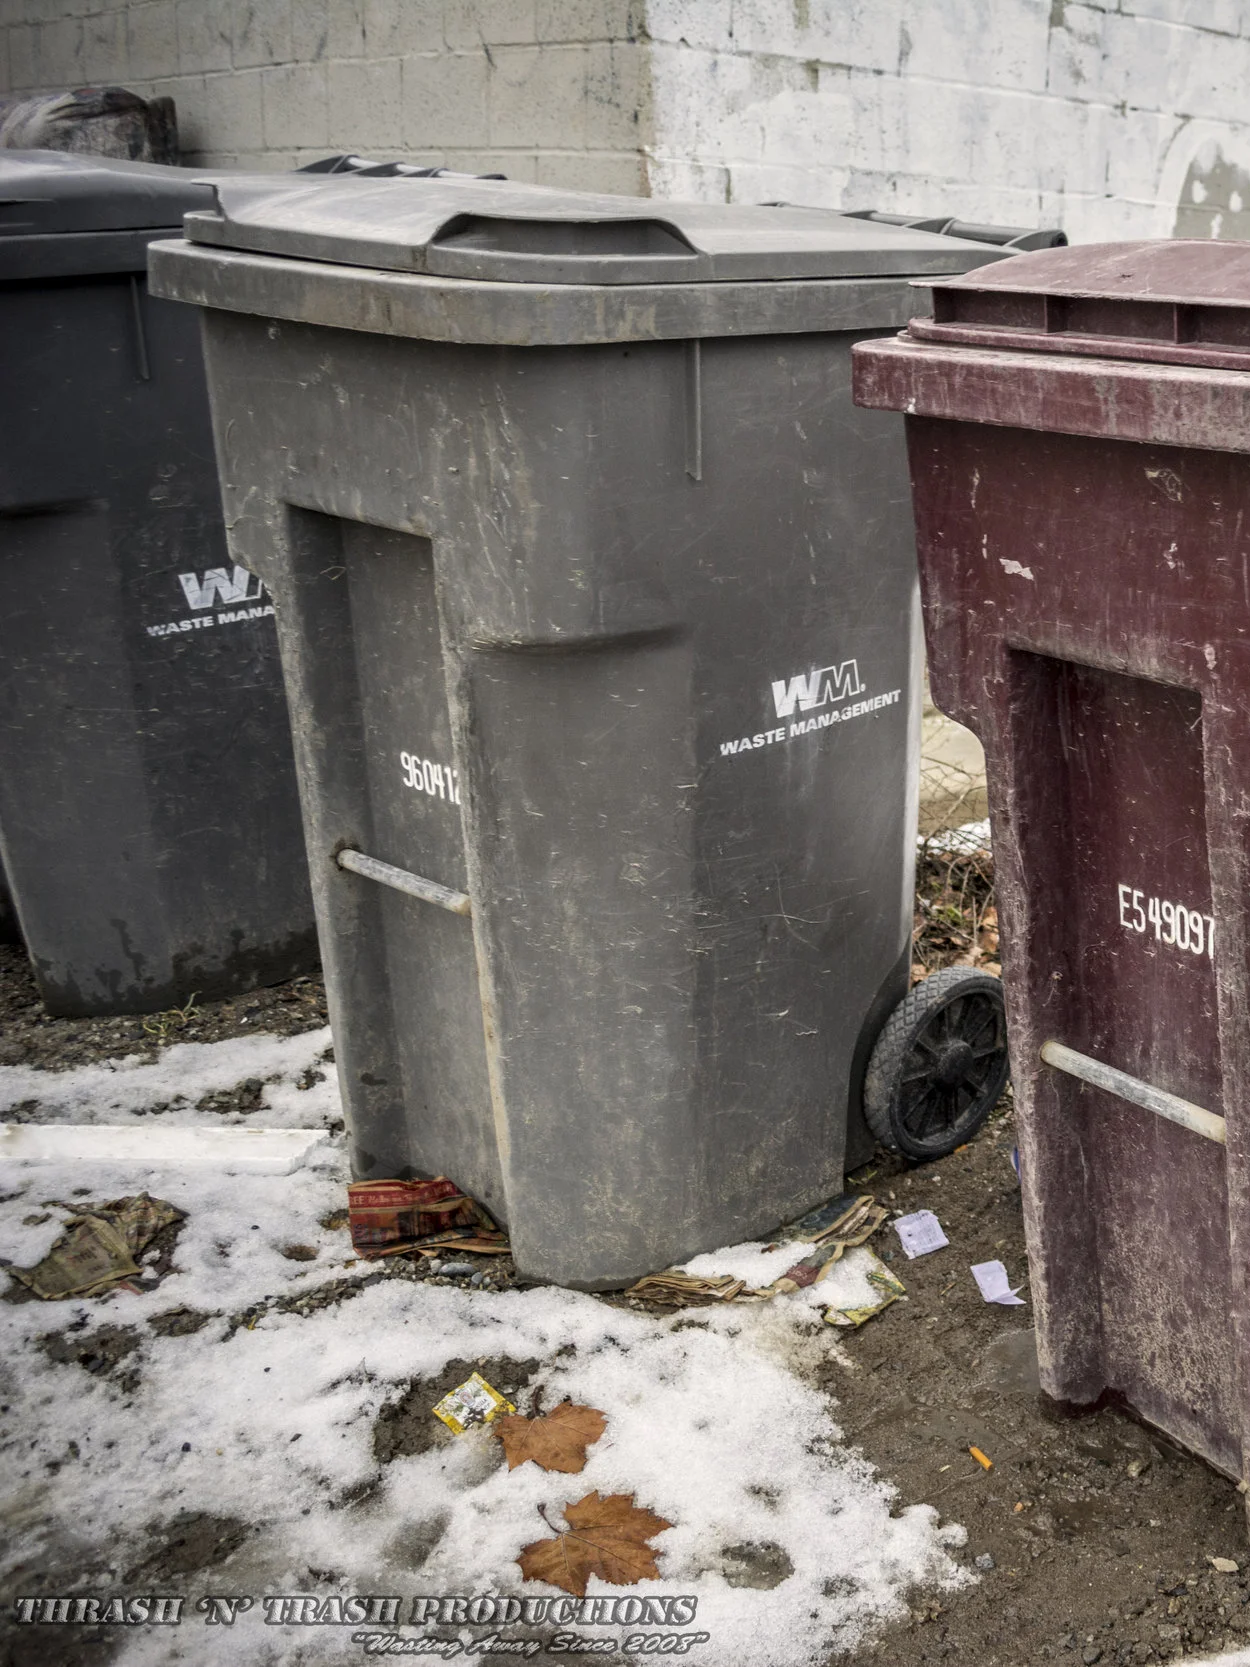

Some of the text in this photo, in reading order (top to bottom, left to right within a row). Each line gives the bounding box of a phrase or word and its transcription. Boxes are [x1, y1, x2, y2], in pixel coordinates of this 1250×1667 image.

[147, 616, 215, 637] WASTE
[771, 658, 861, 718] WM
[719, 688, 902, 757] WASTE MANAGEMENT
[1118, 883, 1216, 961] E549097
